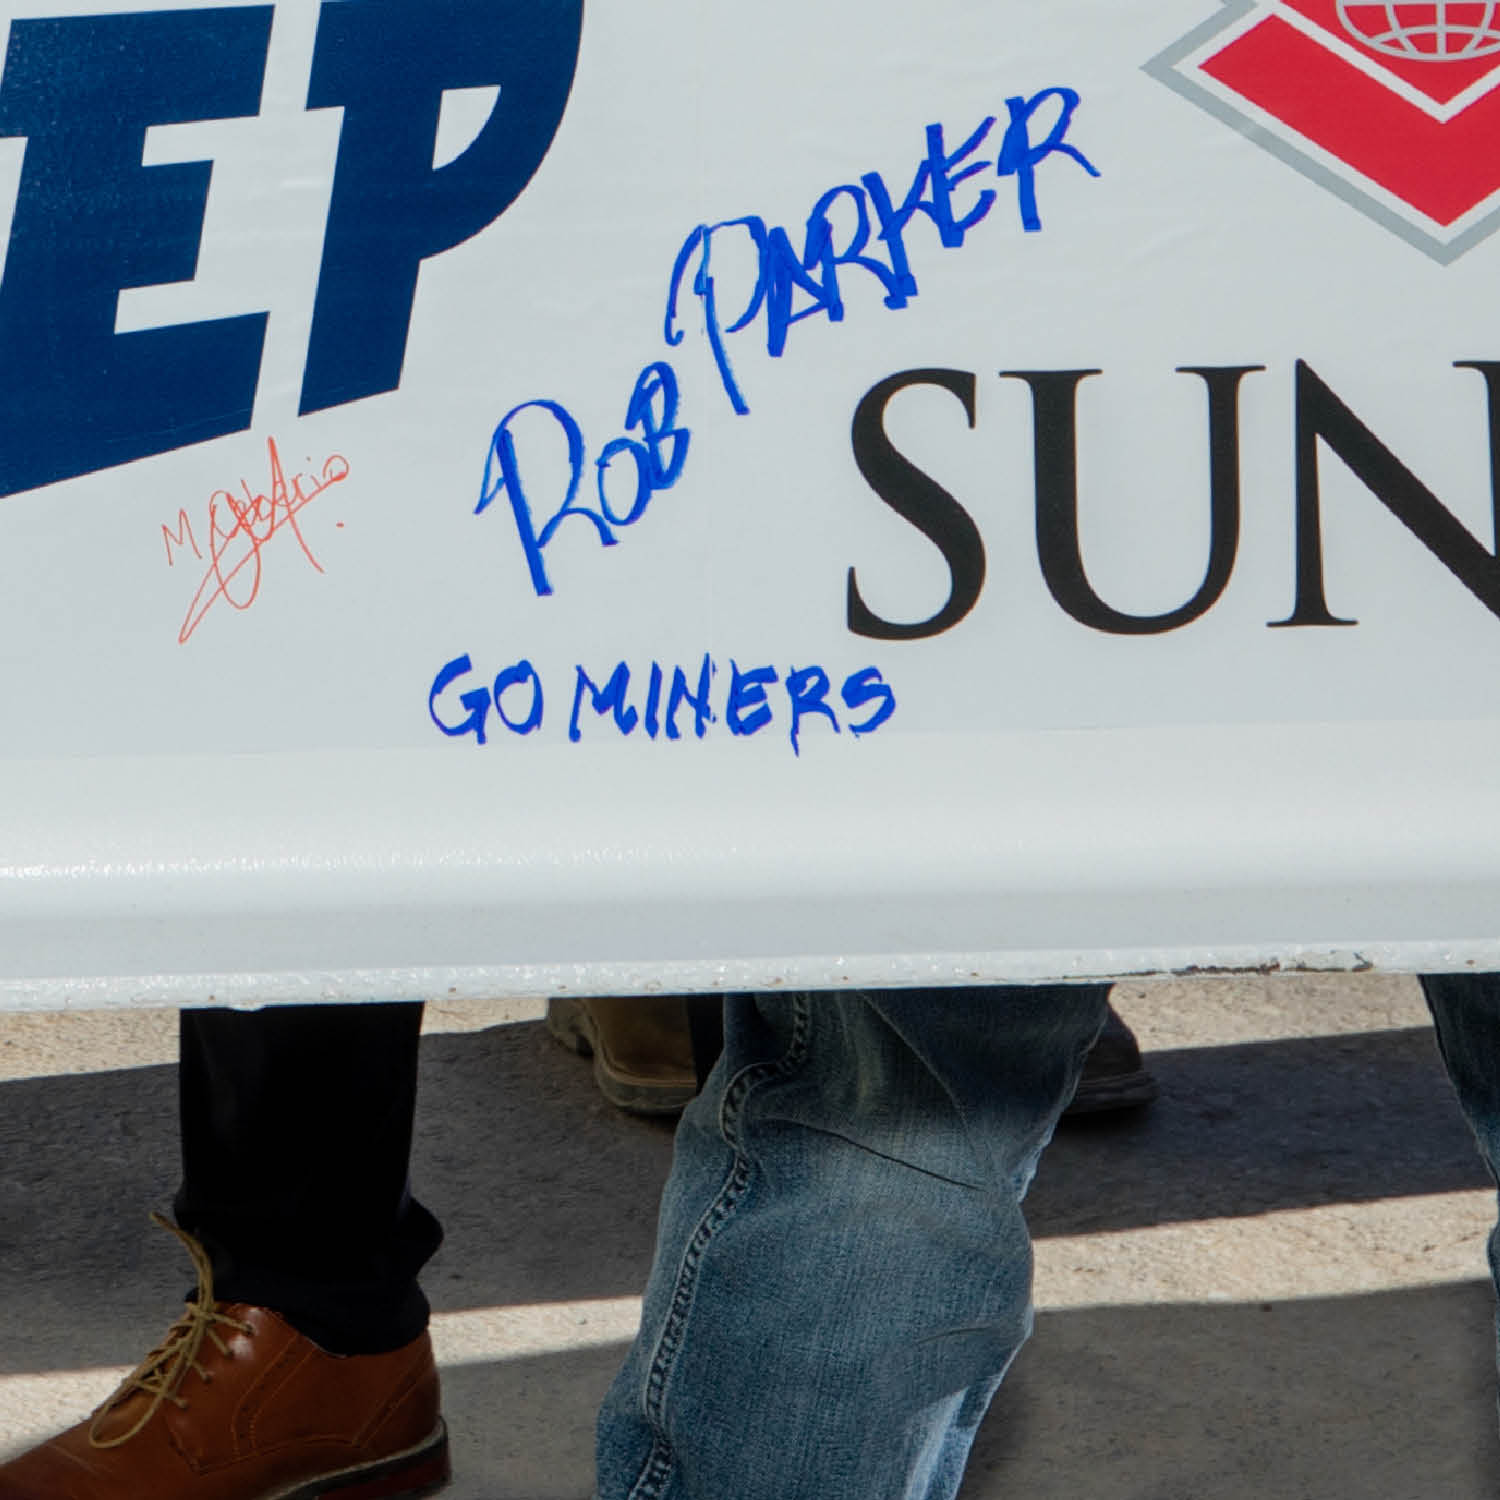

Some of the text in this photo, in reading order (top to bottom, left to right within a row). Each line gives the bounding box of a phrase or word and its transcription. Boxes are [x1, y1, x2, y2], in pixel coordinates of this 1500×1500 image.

[665, 86, 1102, 416] PARKER
[428, 650, 898, 756] GO MINERS
